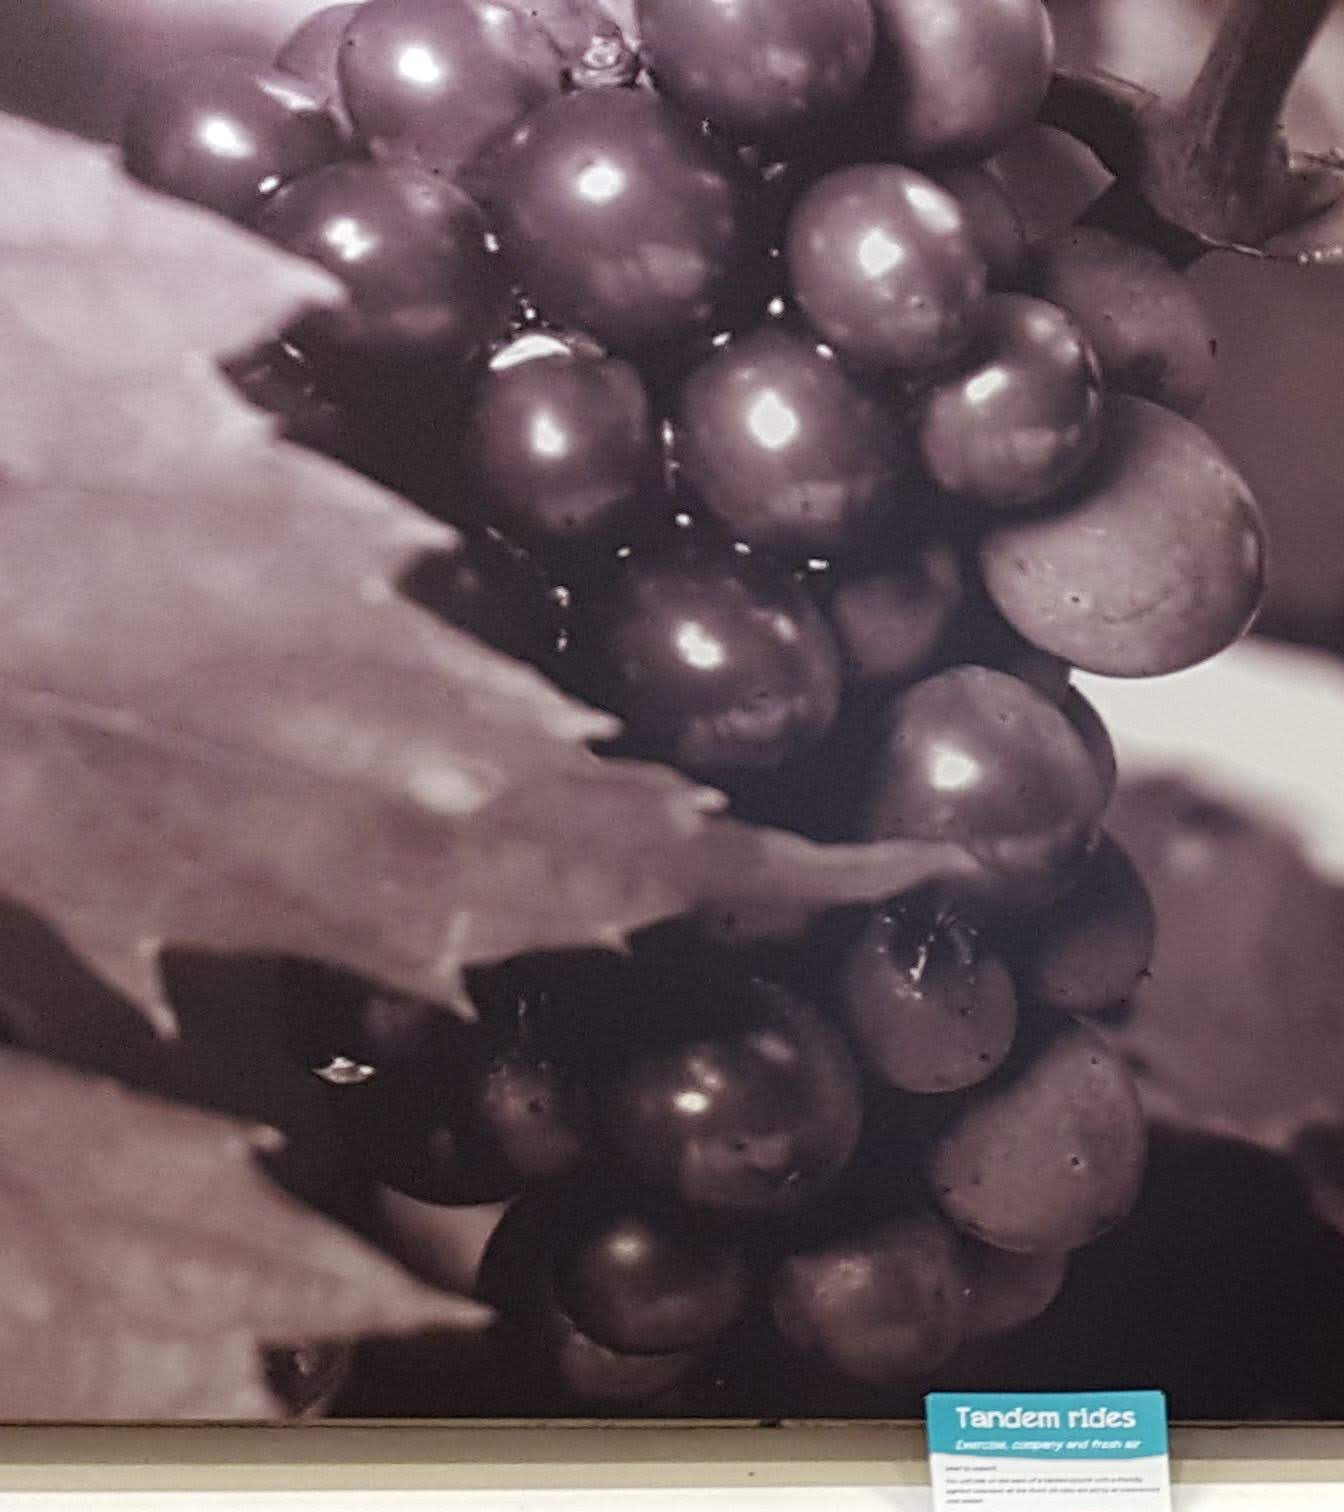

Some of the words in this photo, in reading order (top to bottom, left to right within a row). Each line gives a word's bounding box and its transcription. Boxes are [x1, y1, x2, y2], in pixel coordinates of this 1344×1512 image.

[954, 1406, 1060, 1430] Tandem
[1067, 1406, 1137, 1429] rides
[1011, 1440, 1065, 1452] company
[1065, 1439, 1089, 1449] and
[1091, 1439, 1122, 1449] fresh
[1124, 1440, 1142, 1449] air
